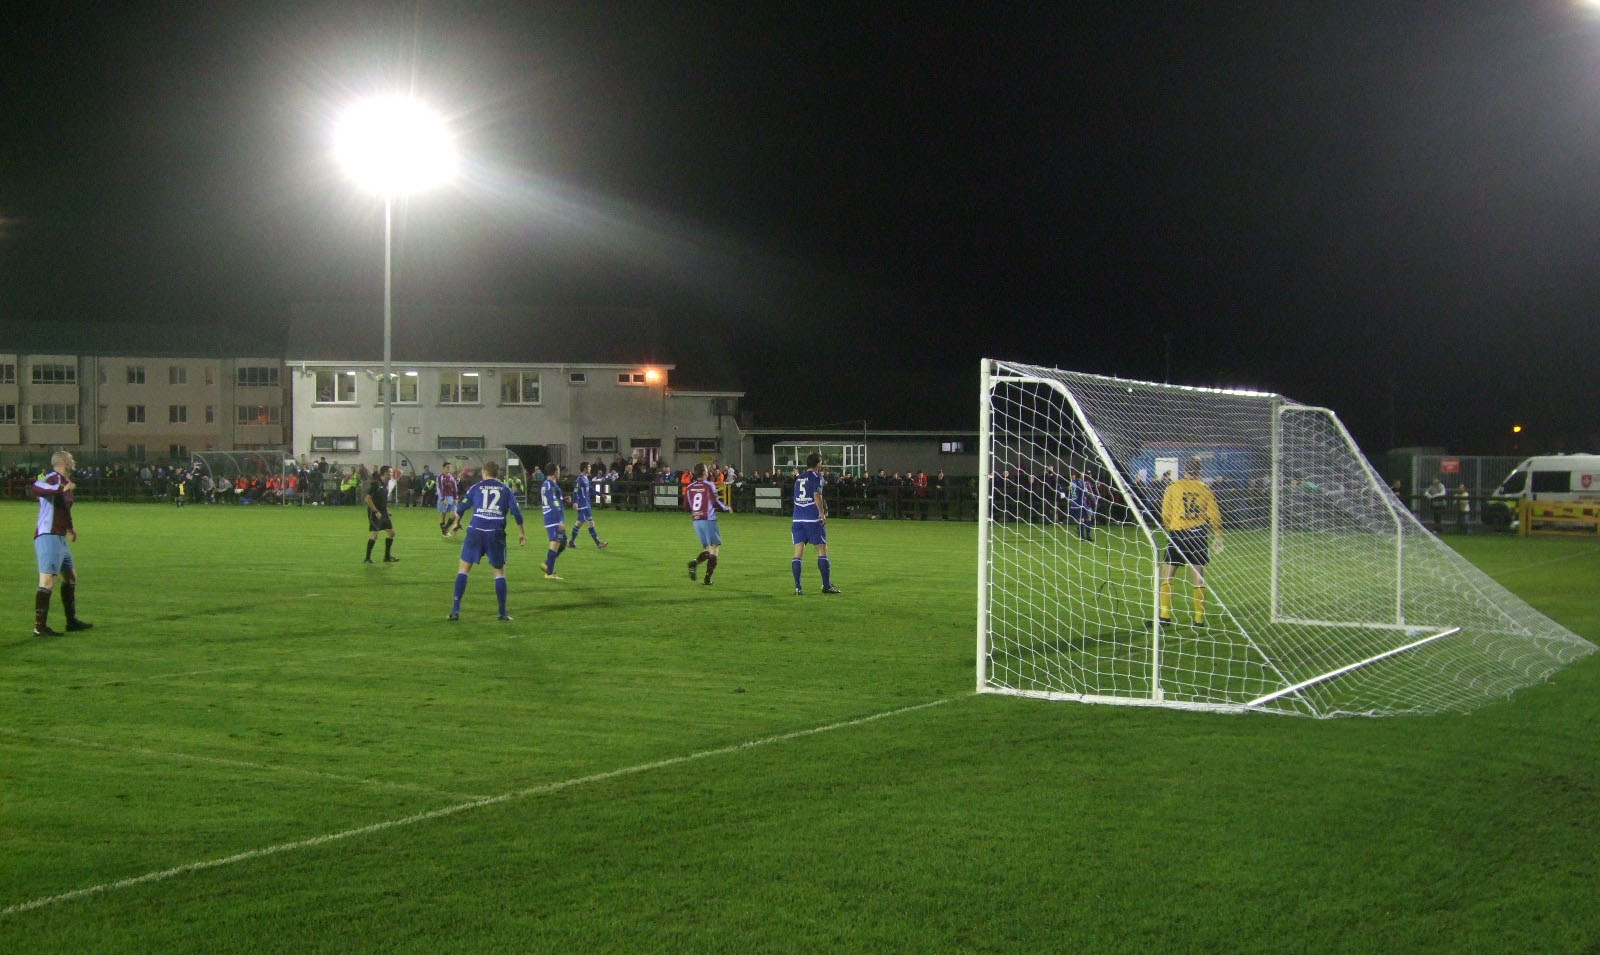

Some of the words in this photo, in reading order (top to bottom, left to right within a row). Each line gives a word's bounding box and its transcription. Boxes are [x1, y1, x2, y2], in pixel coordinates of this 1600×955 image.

[799, 481, 807, 498] 5
[481, 489, 501, 510] 12
[693, 493, 702, 511] 8
